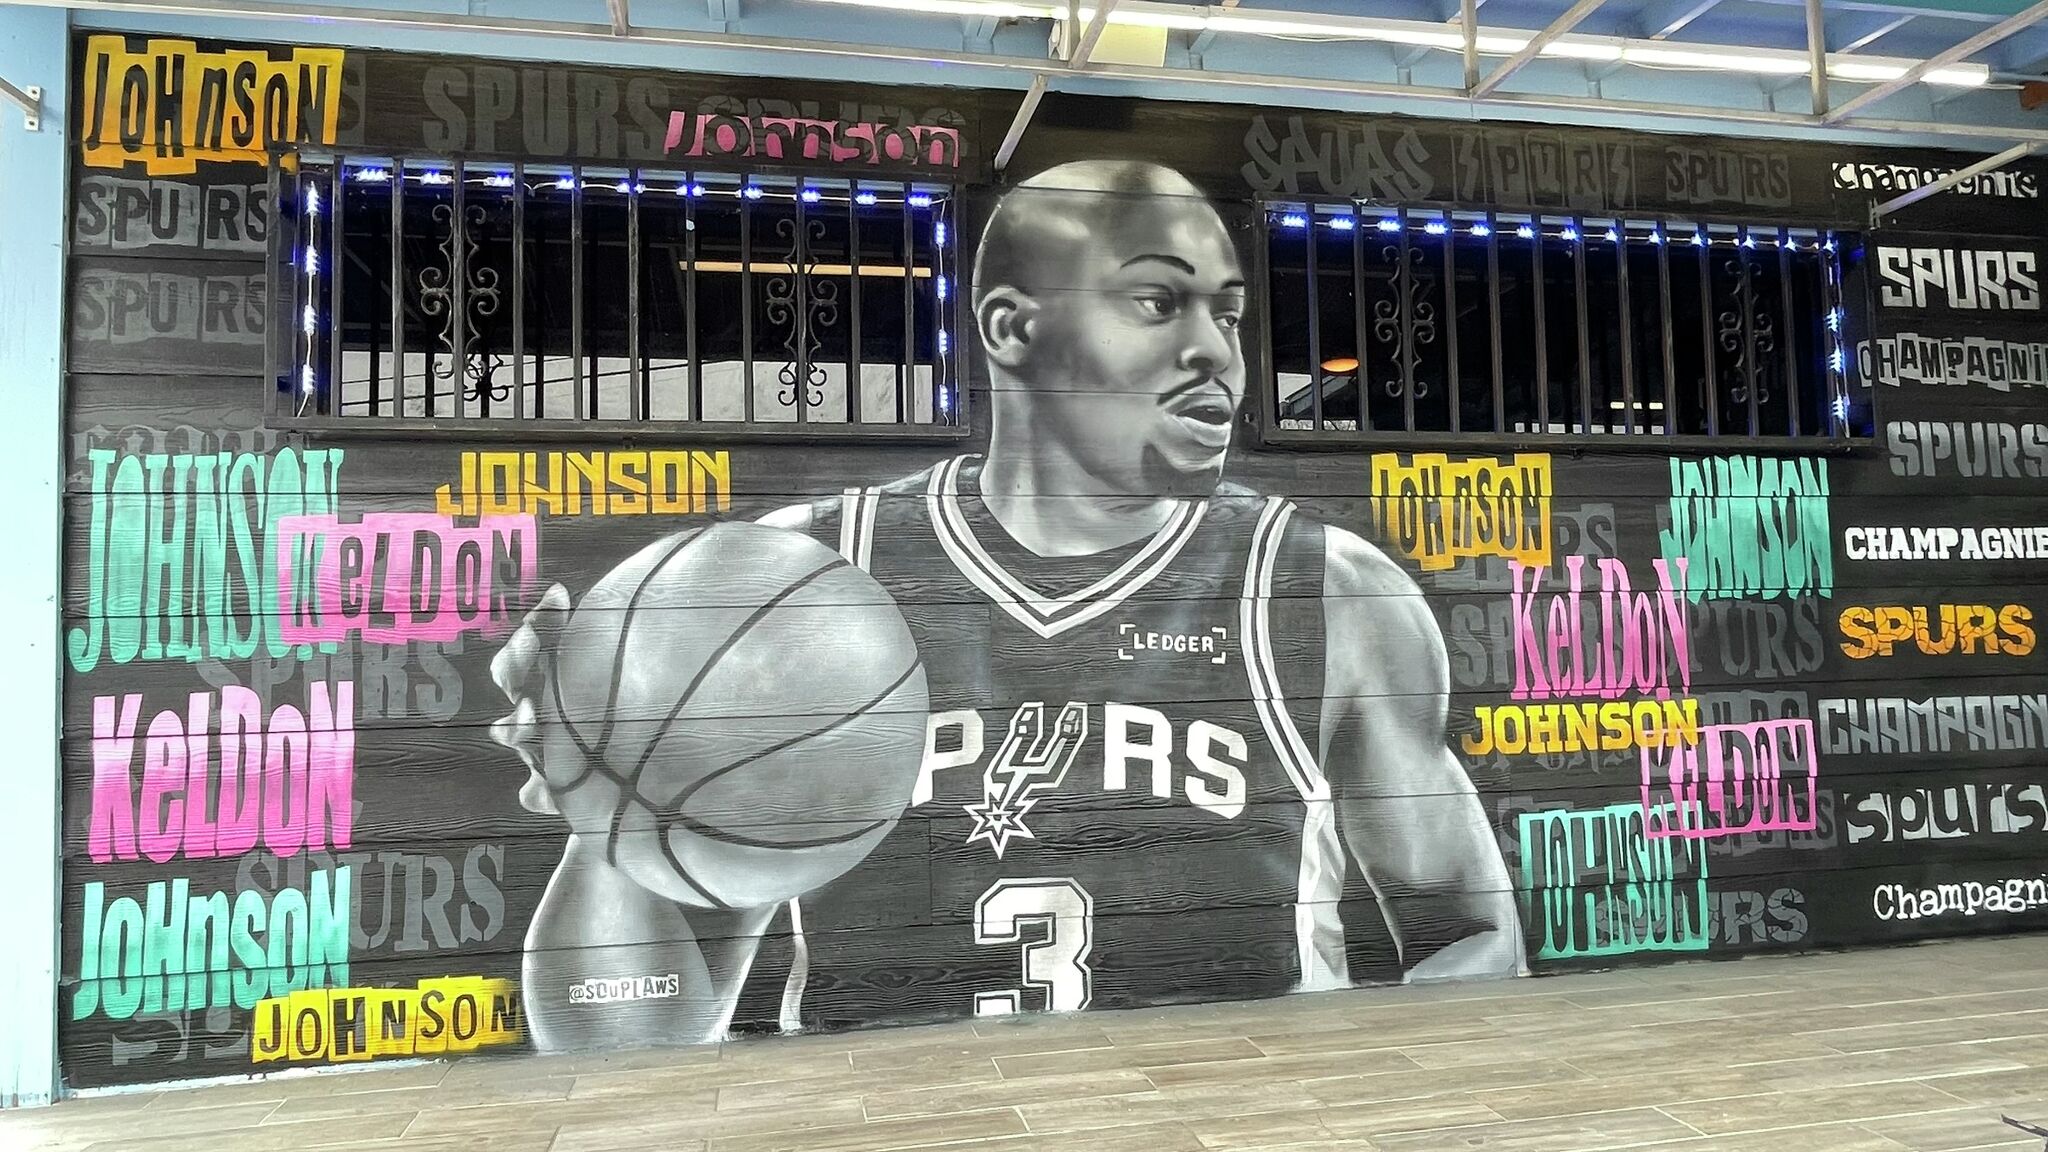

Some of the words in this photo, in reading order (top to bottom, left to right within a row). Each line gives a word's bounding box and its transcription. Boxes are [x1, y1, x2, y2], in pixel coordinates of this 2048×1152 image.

[421, 66, 669, 160] SPURS
[1667, 147, 1788, 200] SPURS
[1877, 247, 2041, 310] SPURS
[1887, 421, 2048, 477] SPURS
[435, 451, 731, 517] JOHNSON
[68, 447, 345, 673] JOHNSON
[1132, 631, 1215, 653] LEDGER
[1839, 603, 2037, 657] SPURS
[1461, 698, 1701, 755] JOHNSON
[973, 877, 1094, 1016] 3
[258, 989, 519, 1056] JOHNSON
